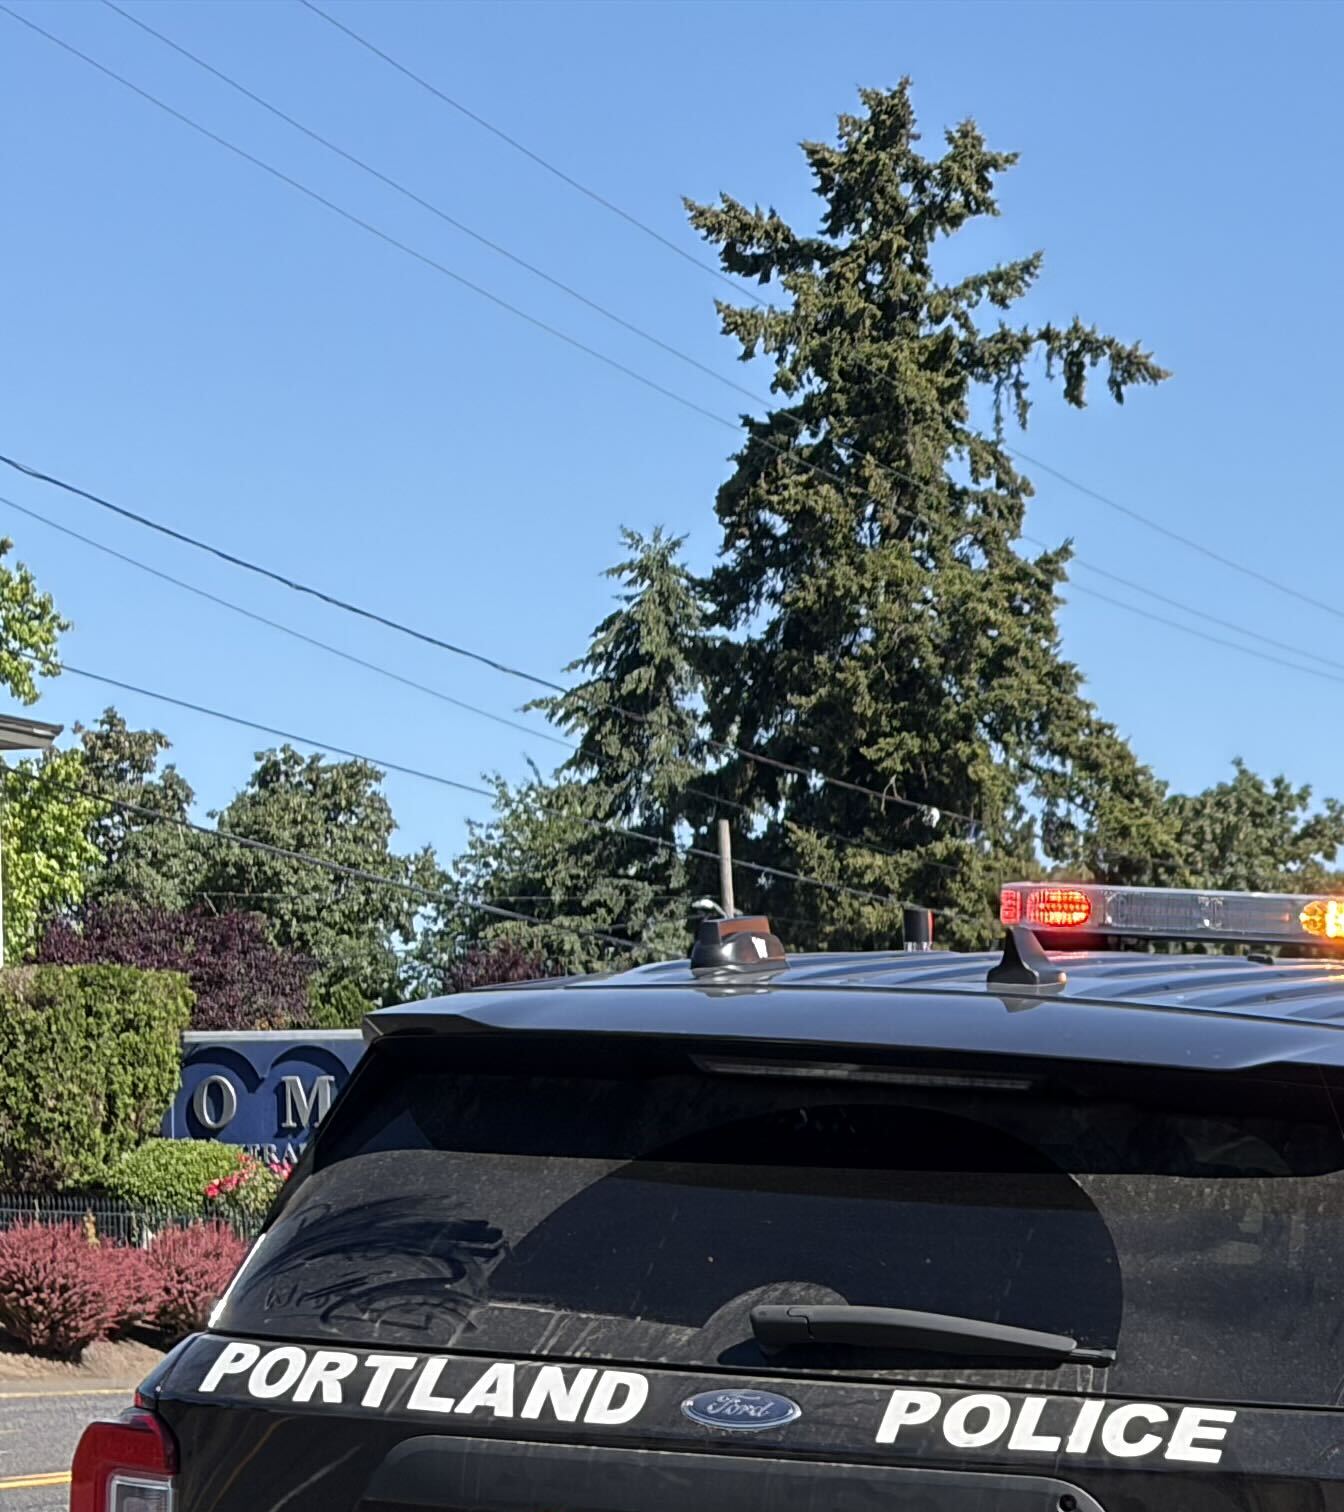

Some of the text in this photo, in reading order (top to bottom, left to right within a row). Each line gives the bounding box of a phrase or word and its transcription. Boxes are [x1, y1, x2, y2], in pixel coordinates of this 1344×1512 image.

[199, 1343, 1237, 1463] PORTLAND POLICE
[706, 1391, 770, 1418] Ford
